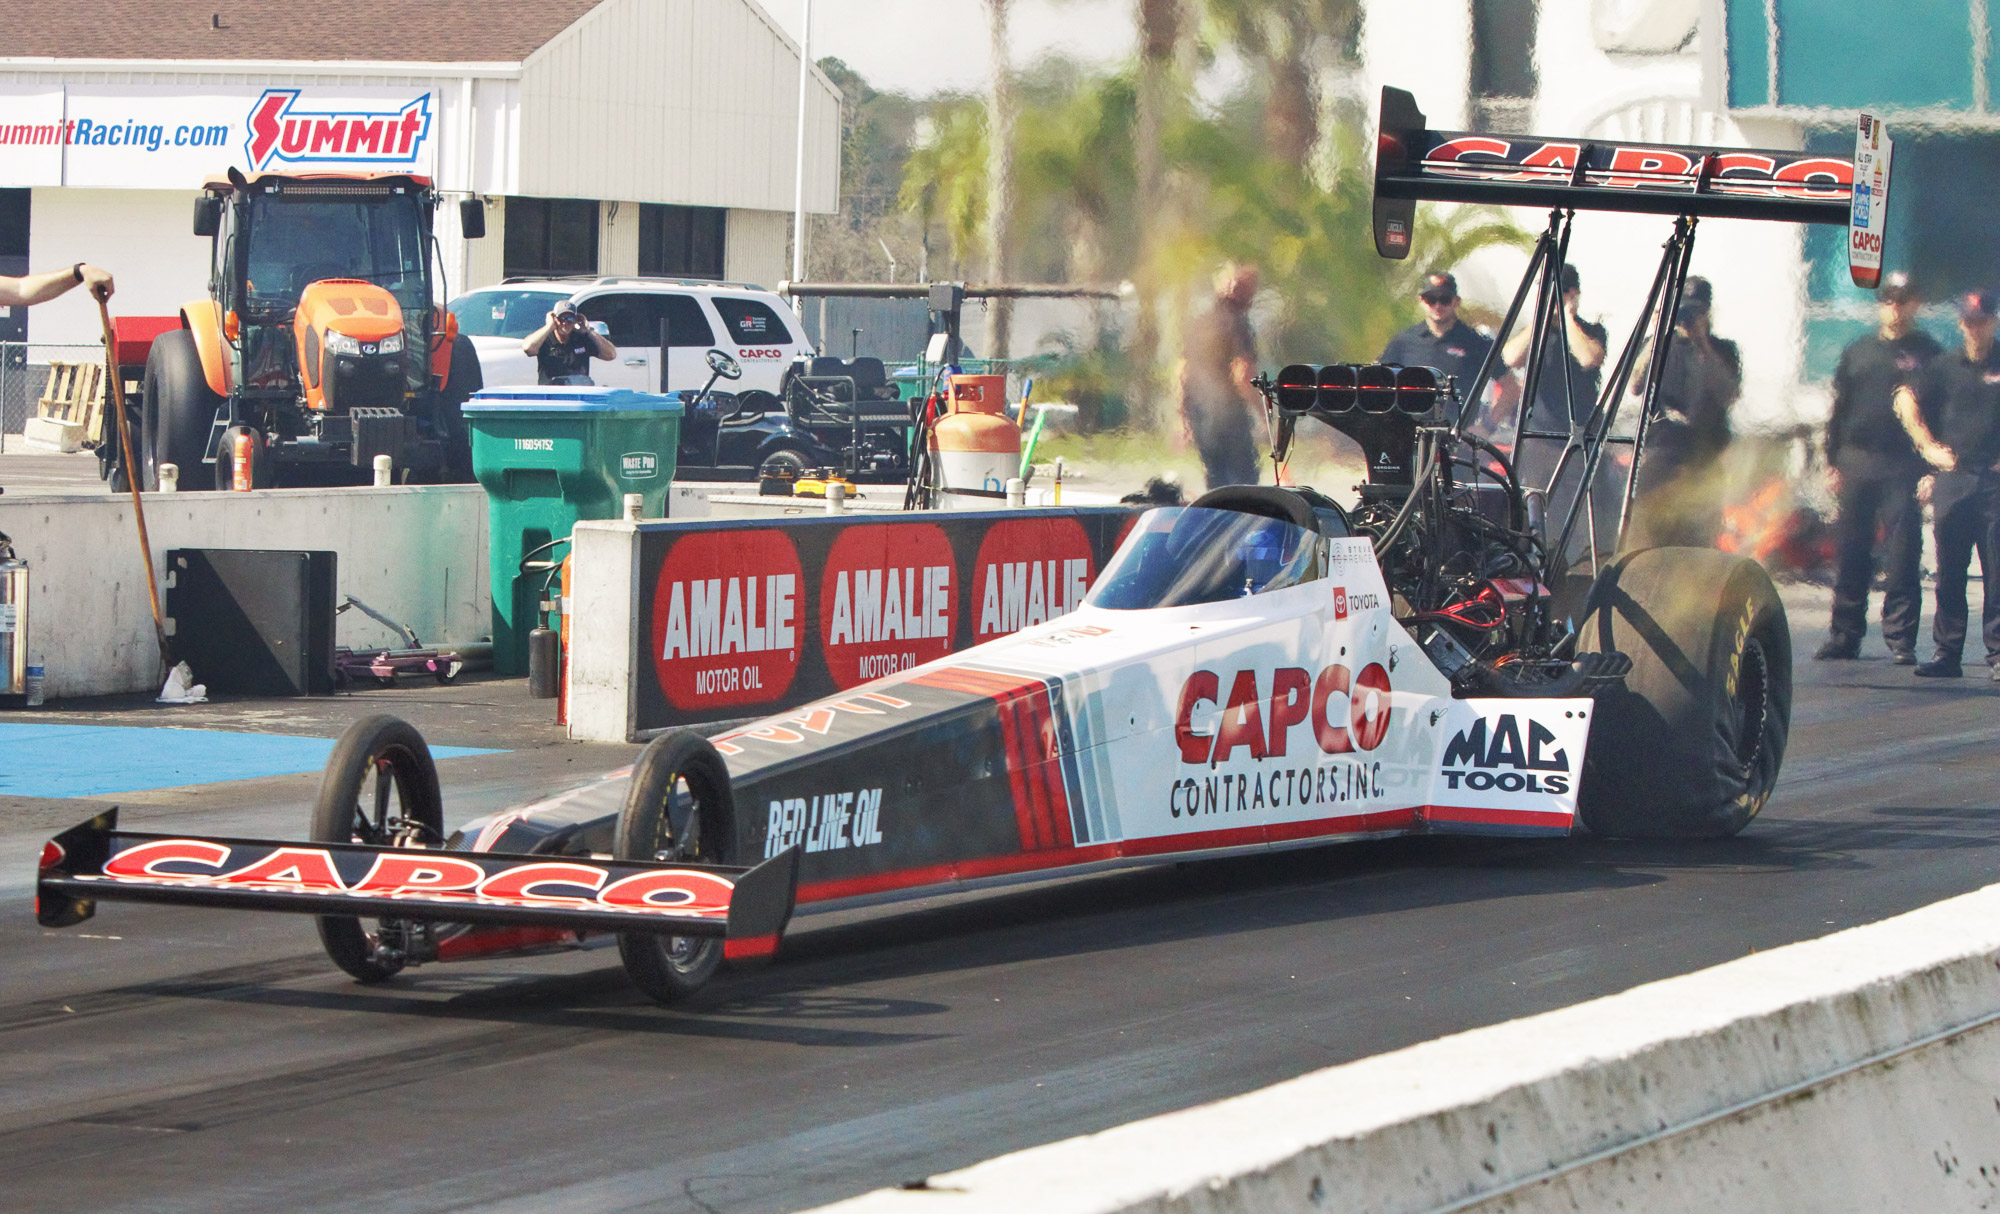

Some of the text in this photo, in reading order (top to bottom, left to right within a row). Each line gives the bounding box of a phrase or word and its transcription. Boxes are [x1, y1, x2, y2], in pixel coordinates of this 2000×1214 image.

[1422, 137, 1854, 200] CAPCO
[1853, 230, 1880, 253] CAPCO
[740, 320, 752, 328] GR
[738, 349, 782, 358] CAPCO
[622, 456, 655, 469] WASTE PRO
[663, 574, 796, 660] AMALIE
[830, 566, 949, 645] AMALIE
[980, 558, 1088, 634] AMALIE
[1348, 594, 1380, 611] TOYOTA
[696, 666, 762, 694] MOTOR OIL
[859, 654, 898, 678] MOTOR
[1174, 662, 1392, 764] CAPCO
[1442, 713, 1570, 772] MAC
[1441, 770, 1570, 795] TOOLS
[764, 788, 883, 859] RED LINE OIL
[102, 839, 736, 911] CAPCO
